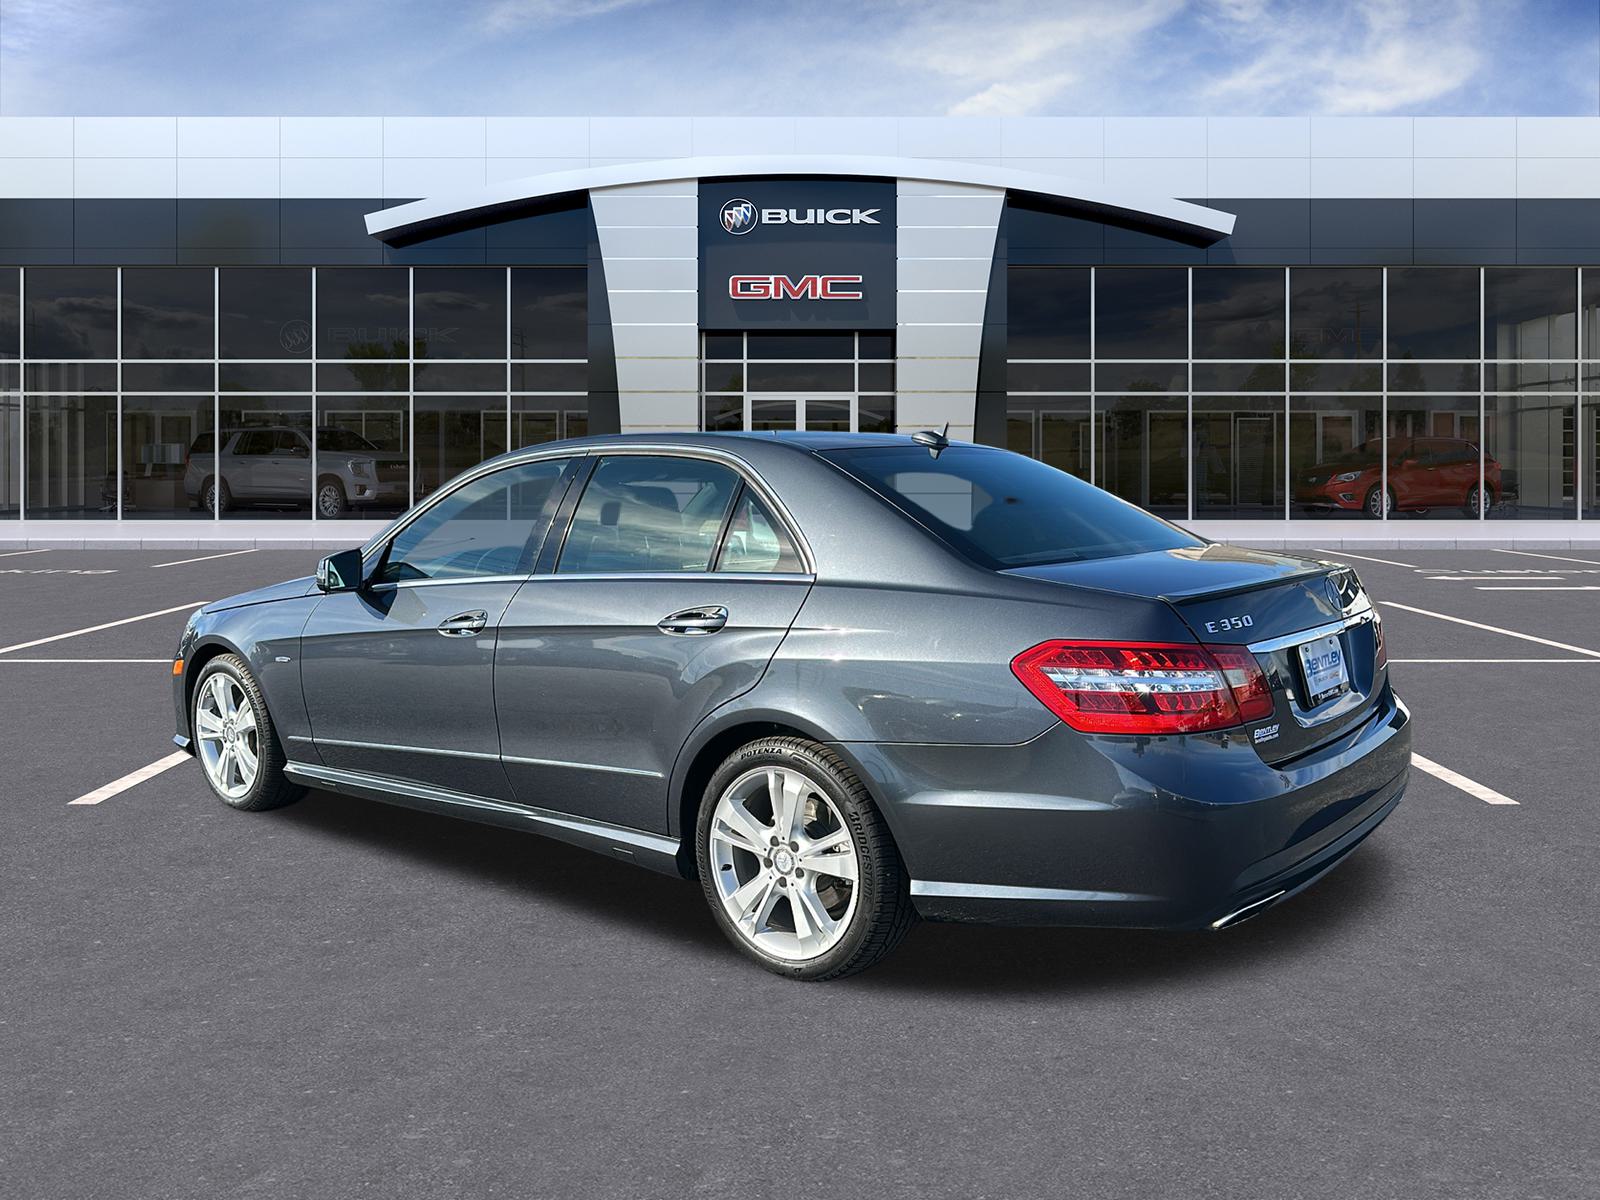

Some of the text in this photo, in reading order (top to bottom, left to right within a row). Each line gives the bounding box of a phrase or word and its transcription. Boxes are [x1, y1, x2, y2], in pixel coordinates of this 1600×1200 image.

[761, 208, 881, 224] BUICK
[729, 275, 863, 299] GMC
[1205, 615, 1254, 634] E 350
[741, 748, 783, 760] POTENZA
[848, 811, 874, 904] BRIDGESTONE
